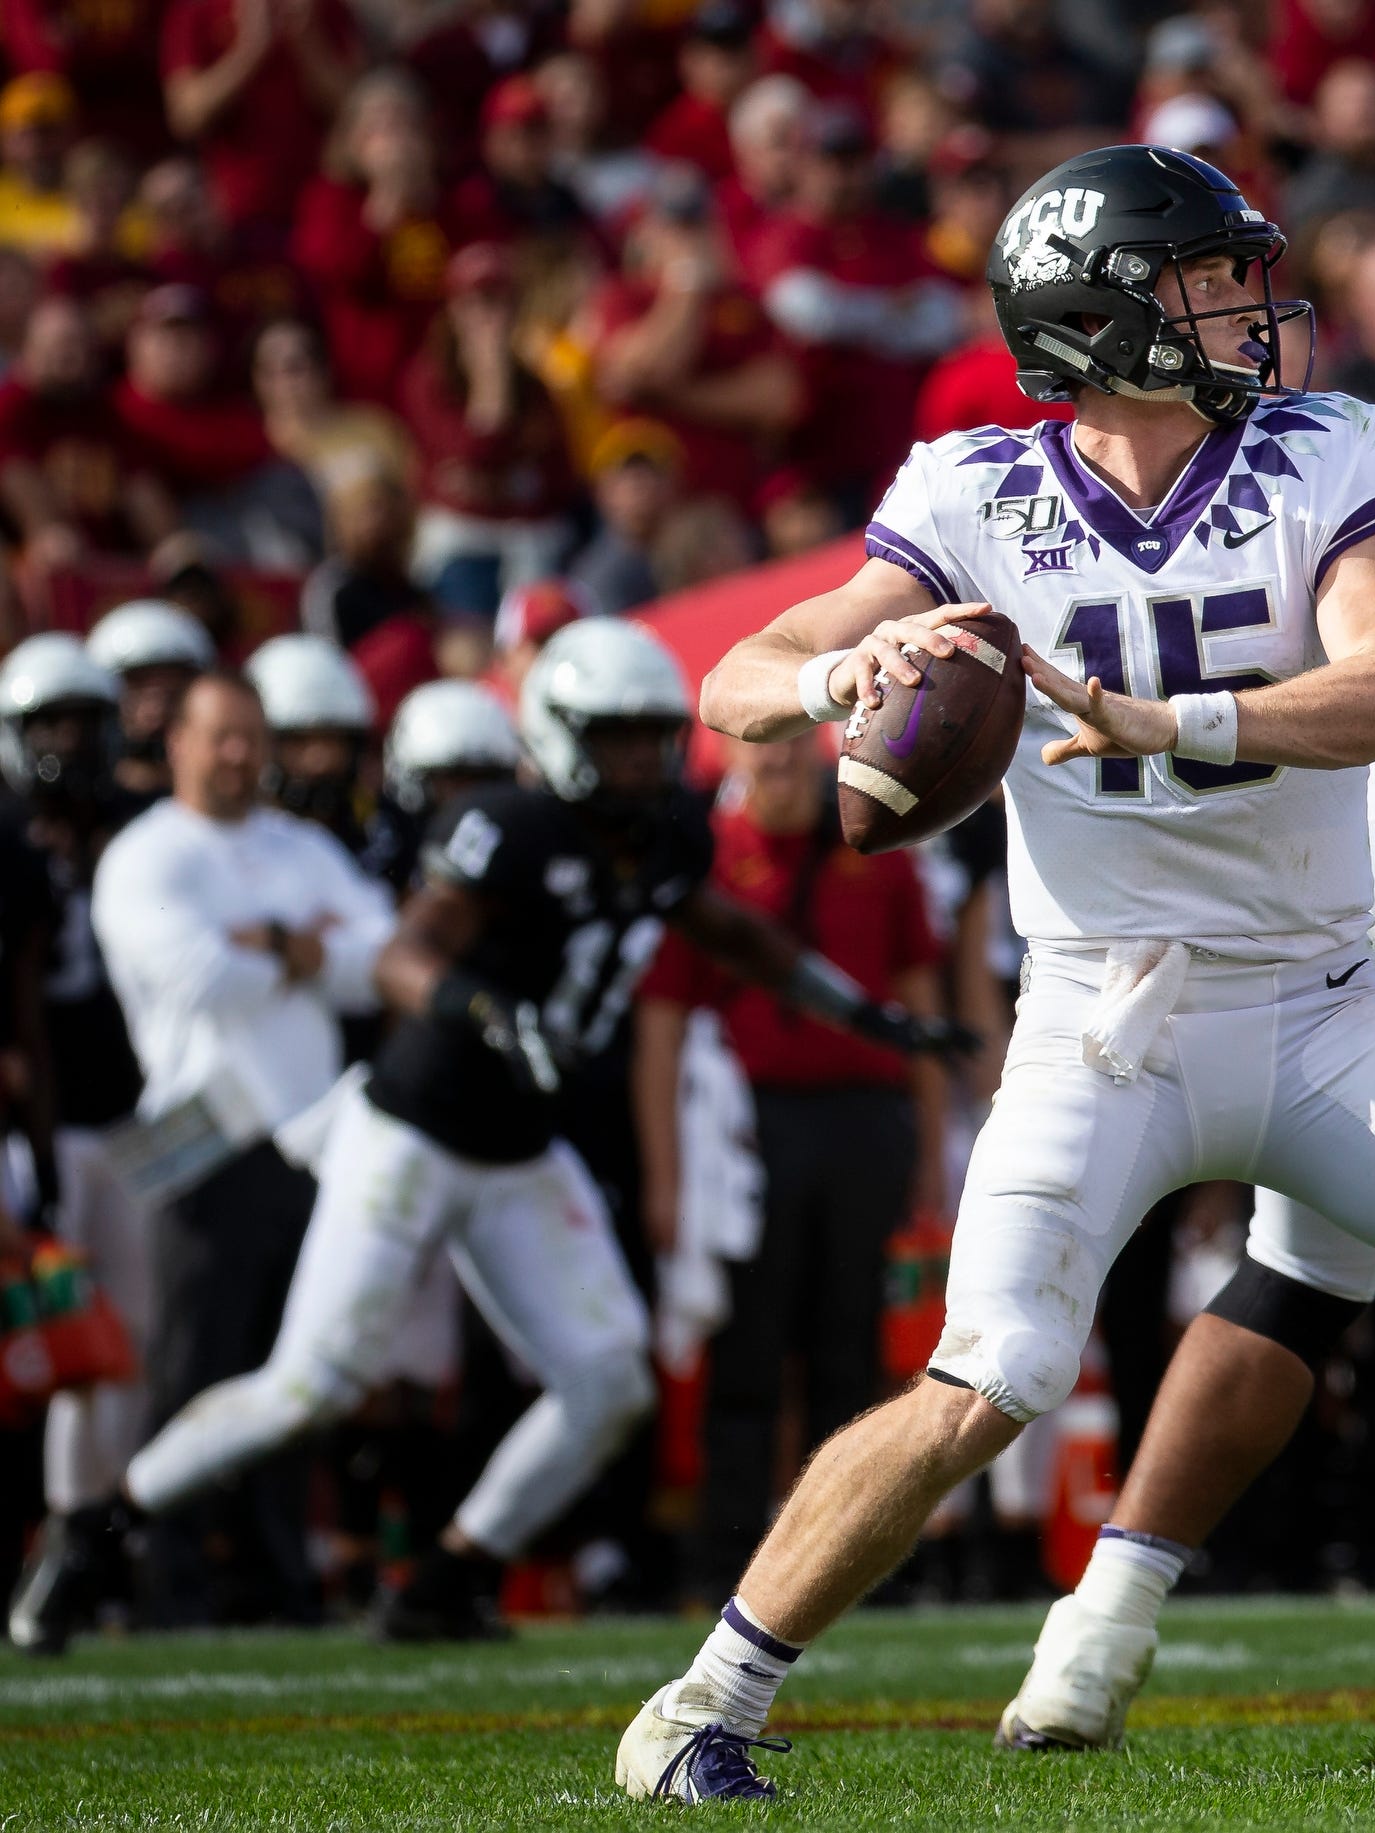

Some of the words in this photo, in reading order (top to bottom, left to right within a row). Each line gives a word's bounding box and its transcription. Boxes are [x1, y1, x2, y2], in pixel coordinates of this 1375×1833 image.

[1002, 188, 1106, 262] TCU
[982, 494, 1060, 538] 150
[1021, 543, 1074, 576] XII
[1137, 540, 1161, 552] TCU
[1050, 576, 1291, 802] 15
